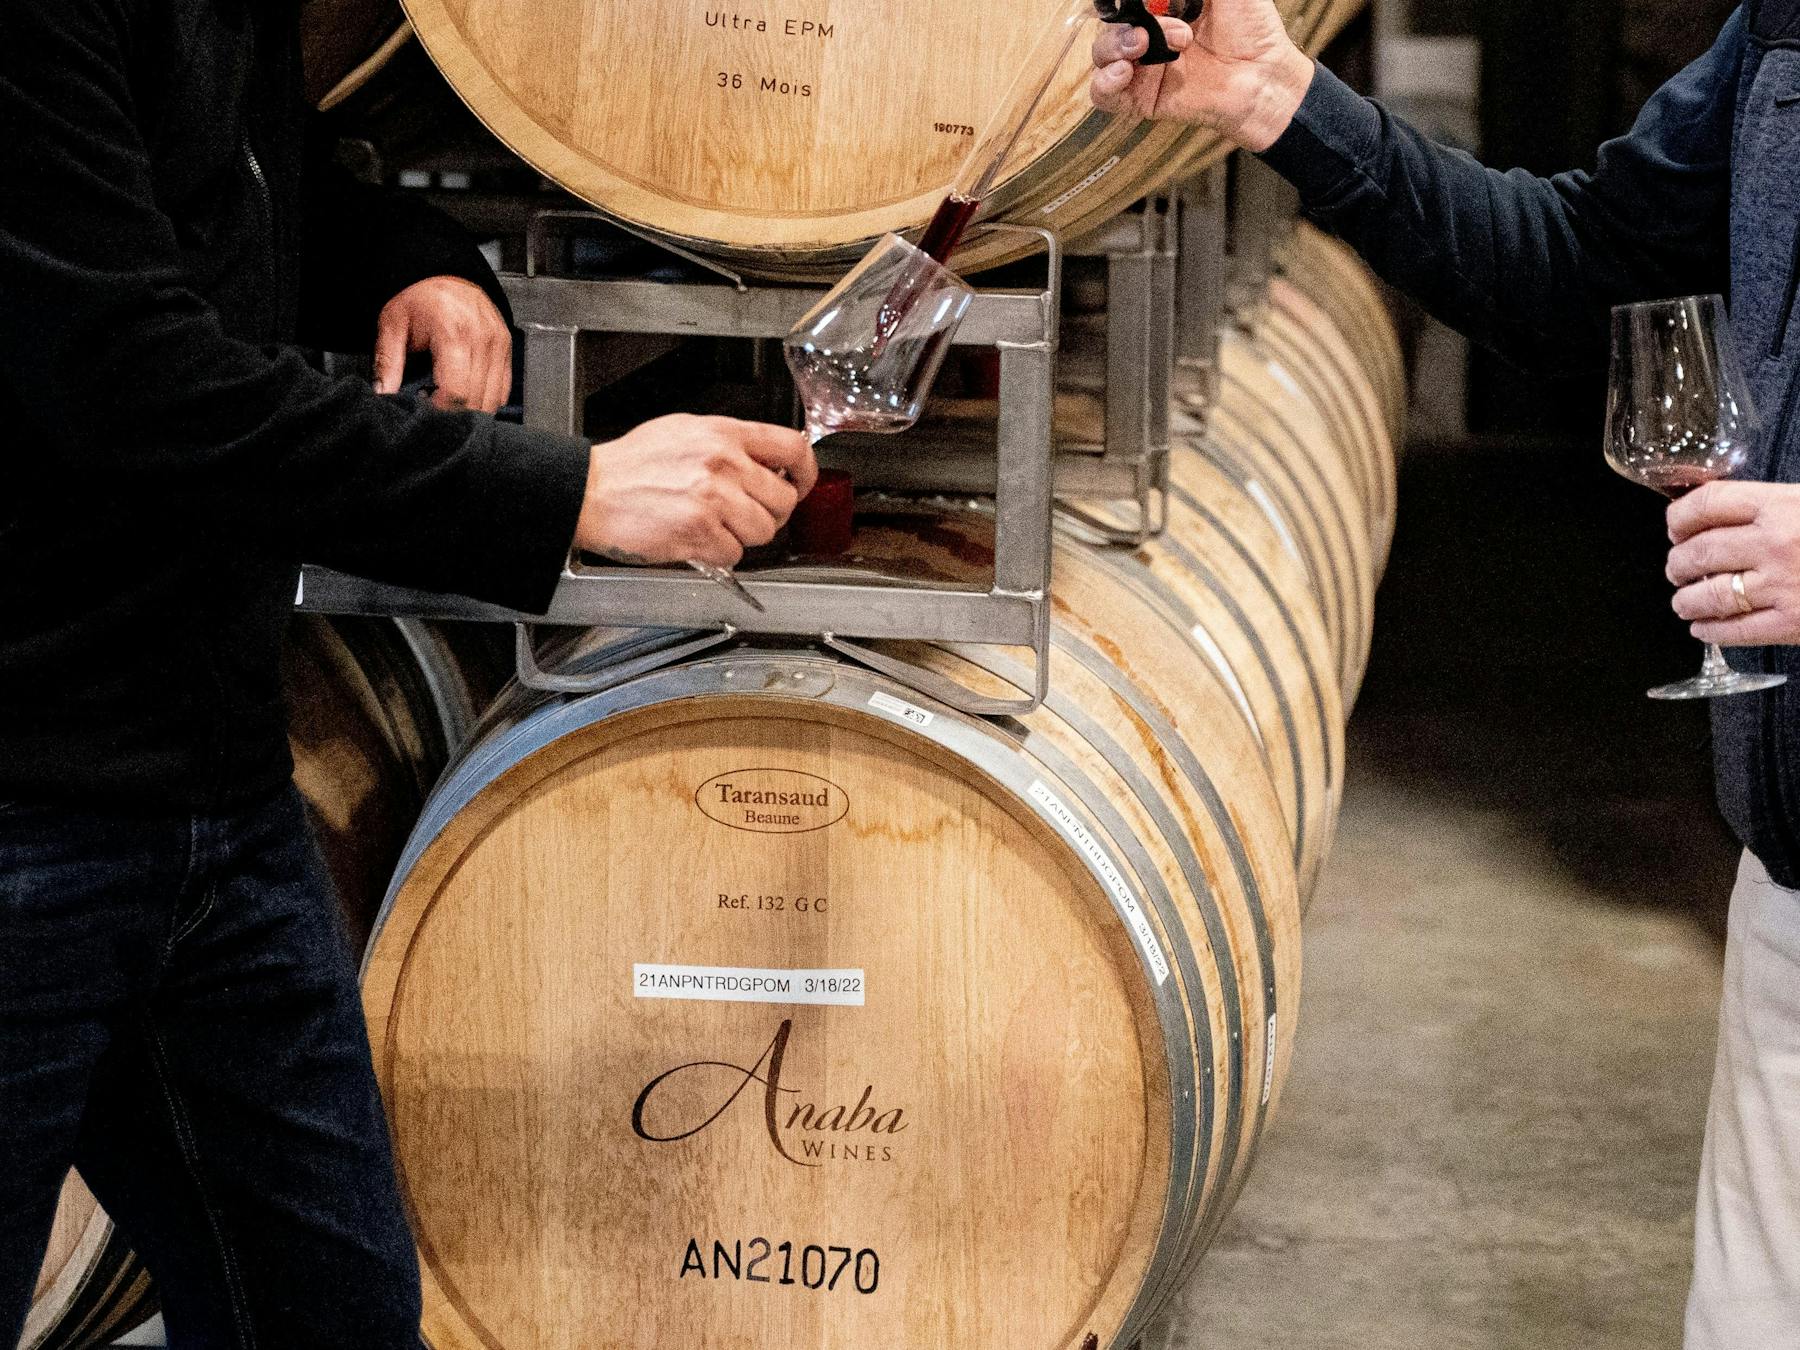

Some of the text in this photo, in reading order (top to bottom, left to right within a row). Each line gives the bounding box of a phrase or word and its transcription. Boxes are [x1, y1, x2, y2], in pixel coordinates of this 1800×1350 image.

[705, 11, 834, 38] Ultra EPM
[716, 72, 811, 97] 36 Mois
[715, 783, 829, 807] Taransaud
[744, 809, 800, 825] Beaune
[717, 894, 750, 910] Ref.
[757, 895, 785, 911] 132
[638, 972, 861, 993] 21ANPNTRDGPOM 3/18/22
[631, 1019, 909, 1167] Anaba
[801, 1139, 892, 1162] WINES
[679, 1236, 880, 1294] AN21070
